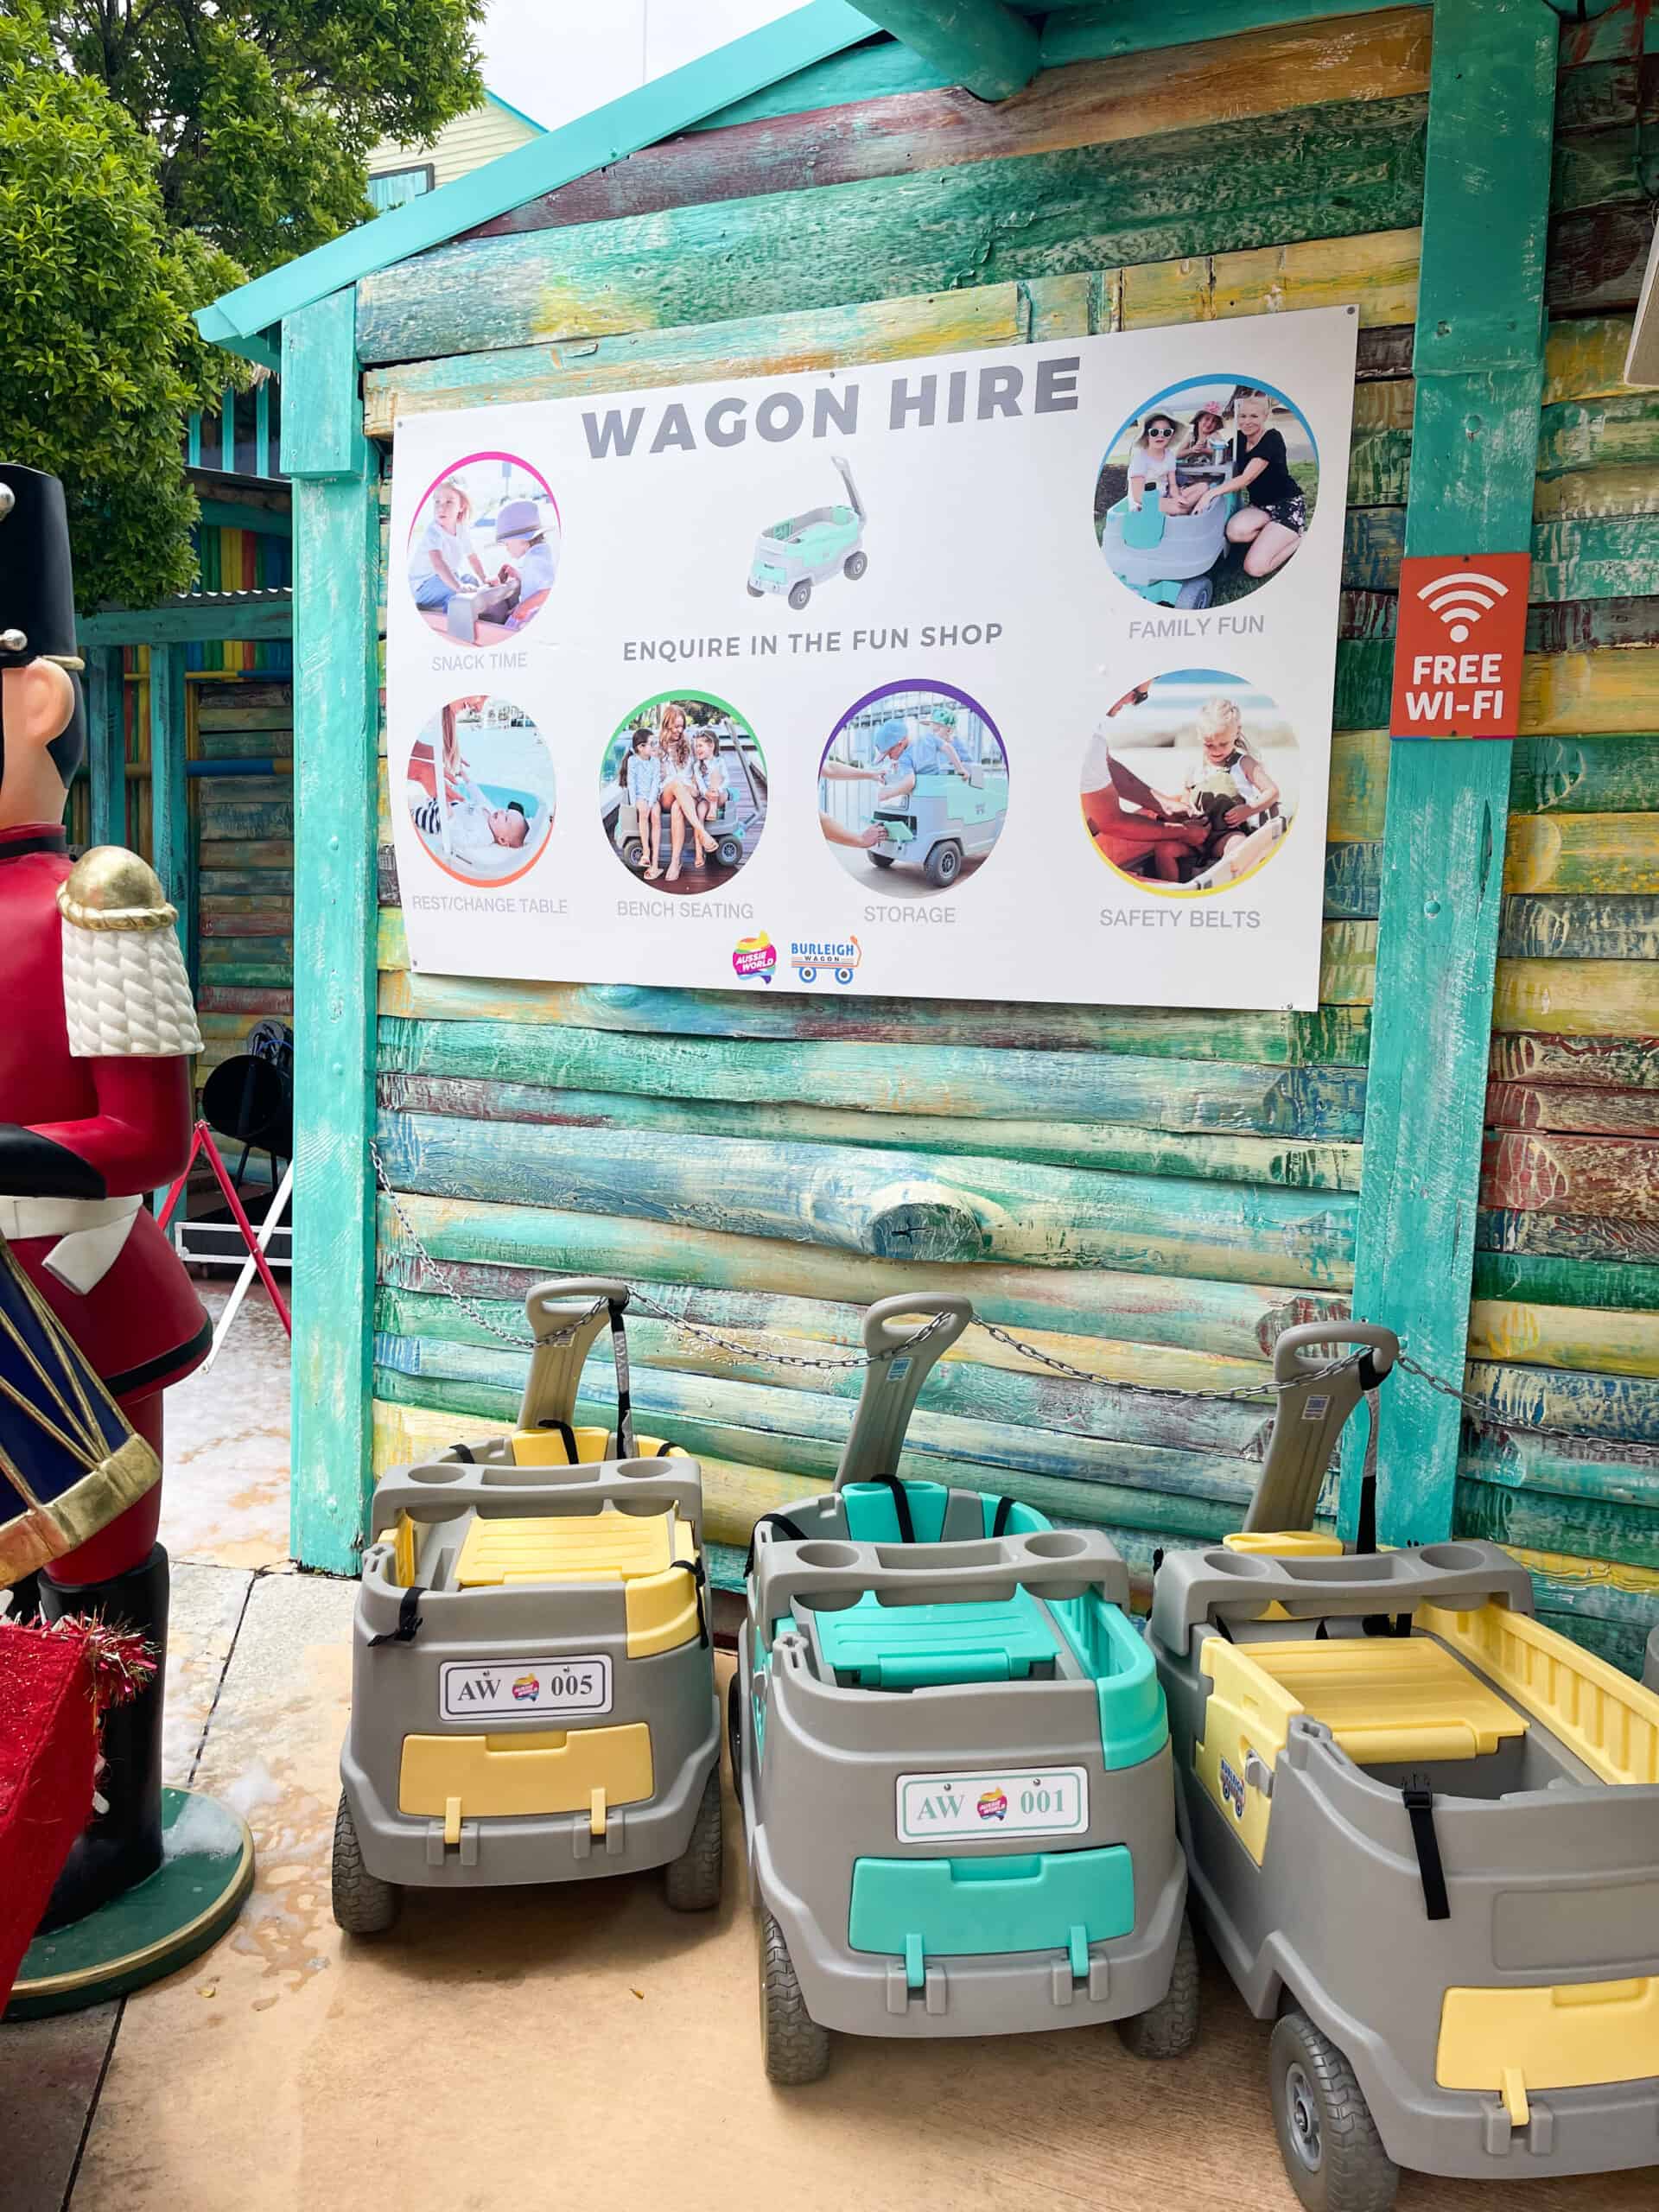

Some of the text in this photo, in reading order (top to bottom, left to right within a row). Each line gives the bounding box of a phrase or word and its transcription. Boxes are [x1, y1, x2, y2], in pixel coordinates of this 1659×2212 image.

[582, 356, 1080, 458] WAGON HIRE
[1128, 614, 1264, 640] FAMILY FUN
[623, 622, 1003, 663] ENQUIRE IN THE FUN SHOP
[431, 652, 528, 671] SNACK TIME
[1412, 652, 1502, 686] FREE
[1405, 690, 1503, 721] WI-FI
[412, 894, 568, 915] REST/CHANGE TABLE
[616, 900, 754, 921] BENCH SEATING
[864, 905, 956, 925] STORAGE
[1099, 909, 1262, 930] SAFETY BELTS
[736, 950, 767, 965] AUSSIE
[791, 943, 854, 957] BURLEIGH
[741, 957, 774, 972] WORLD
[457, 1679, 501, 1701] AW
[550, 1675, 593, 1696] 005
[917, 1789, 1065, 1821] AW 001
